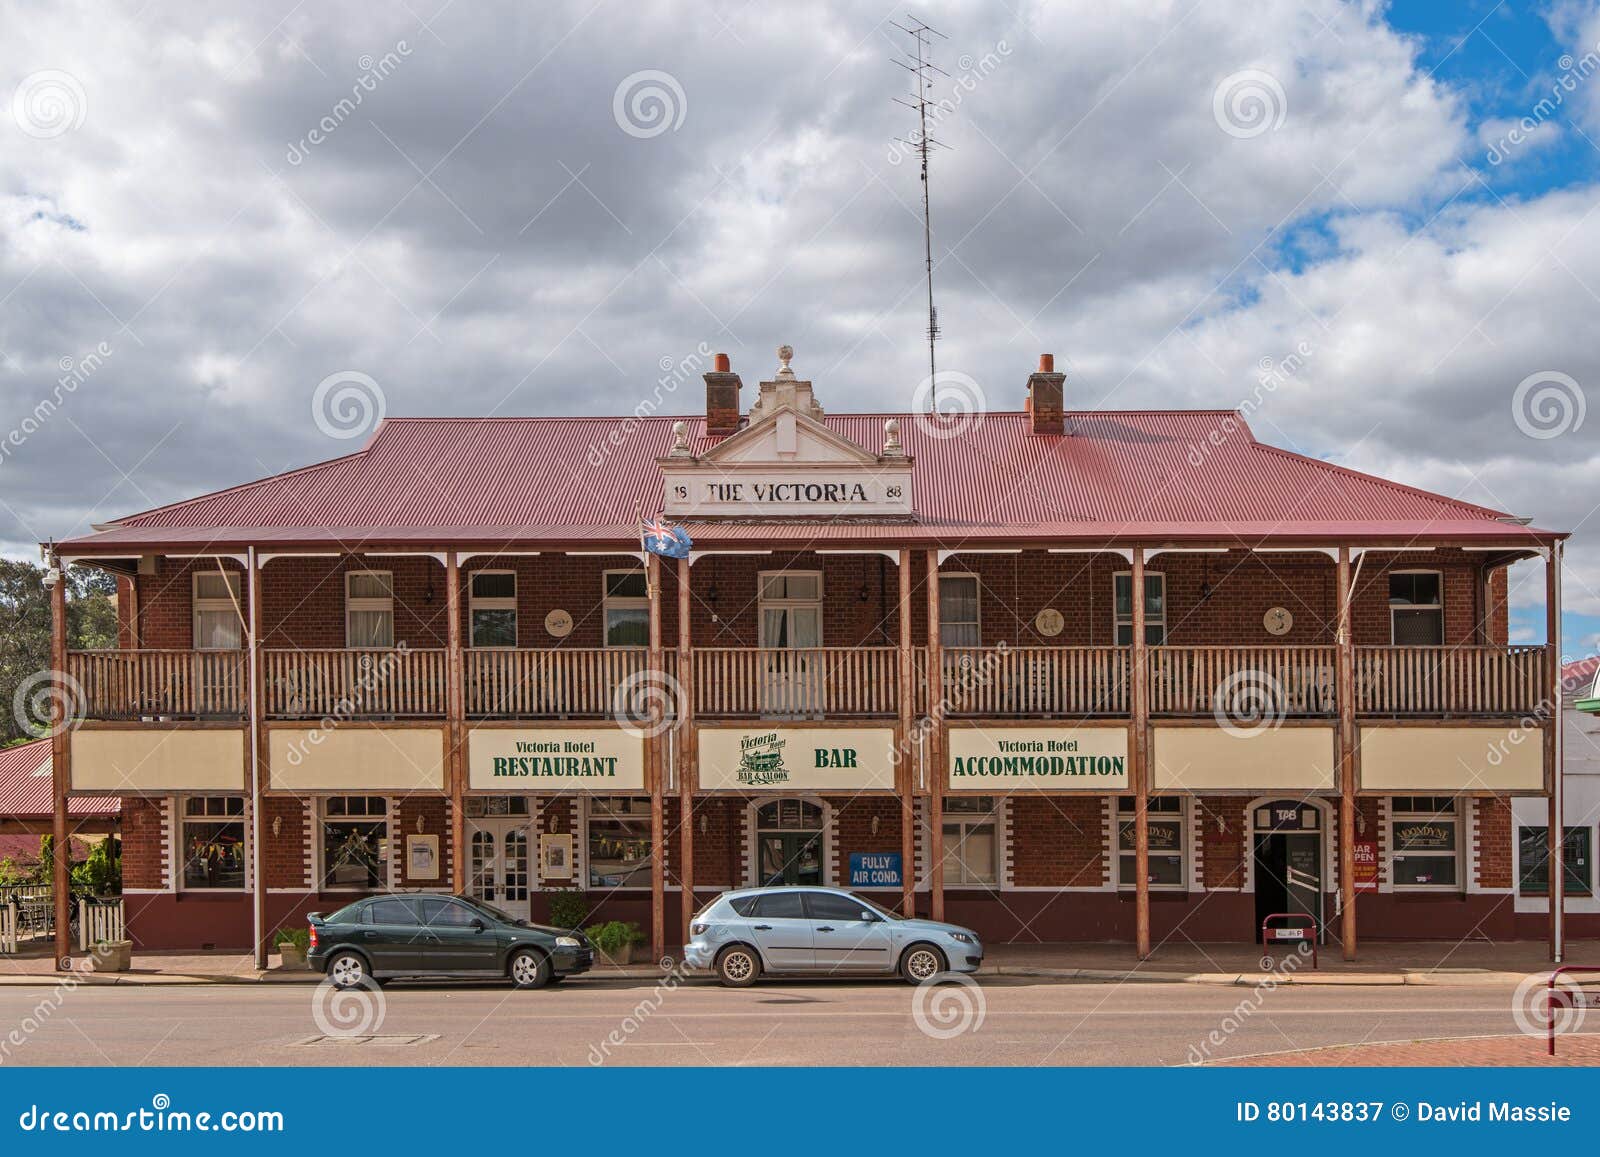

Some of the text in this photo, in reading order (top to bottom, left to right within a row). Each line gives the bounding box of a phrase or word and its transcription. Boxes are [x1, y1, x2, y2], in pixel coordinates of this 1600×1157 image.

[707, 483, 869, 502] THE VICTORIA
[516, 741, 595, 753] Victoria Hotel
[741, 732, 778, 750] Victoria
[998, 740, 1078, 752] Victoria Hotel
[814, 748, 857, 769] BAR
[493, 757, 617, 777] RESTAURANT
[953, 756, 1125, 776] ACCOMMODATION
[738, 772, 753, 780] BAR
[762, 772, 788, 780] SALOON
[1276, 809, 1297, 821] TAB
[862, 856, 890, 869] FULLY
[1354, 853, 1375, 862] PEN
[853, 870, 900, 883] AIR COND.
